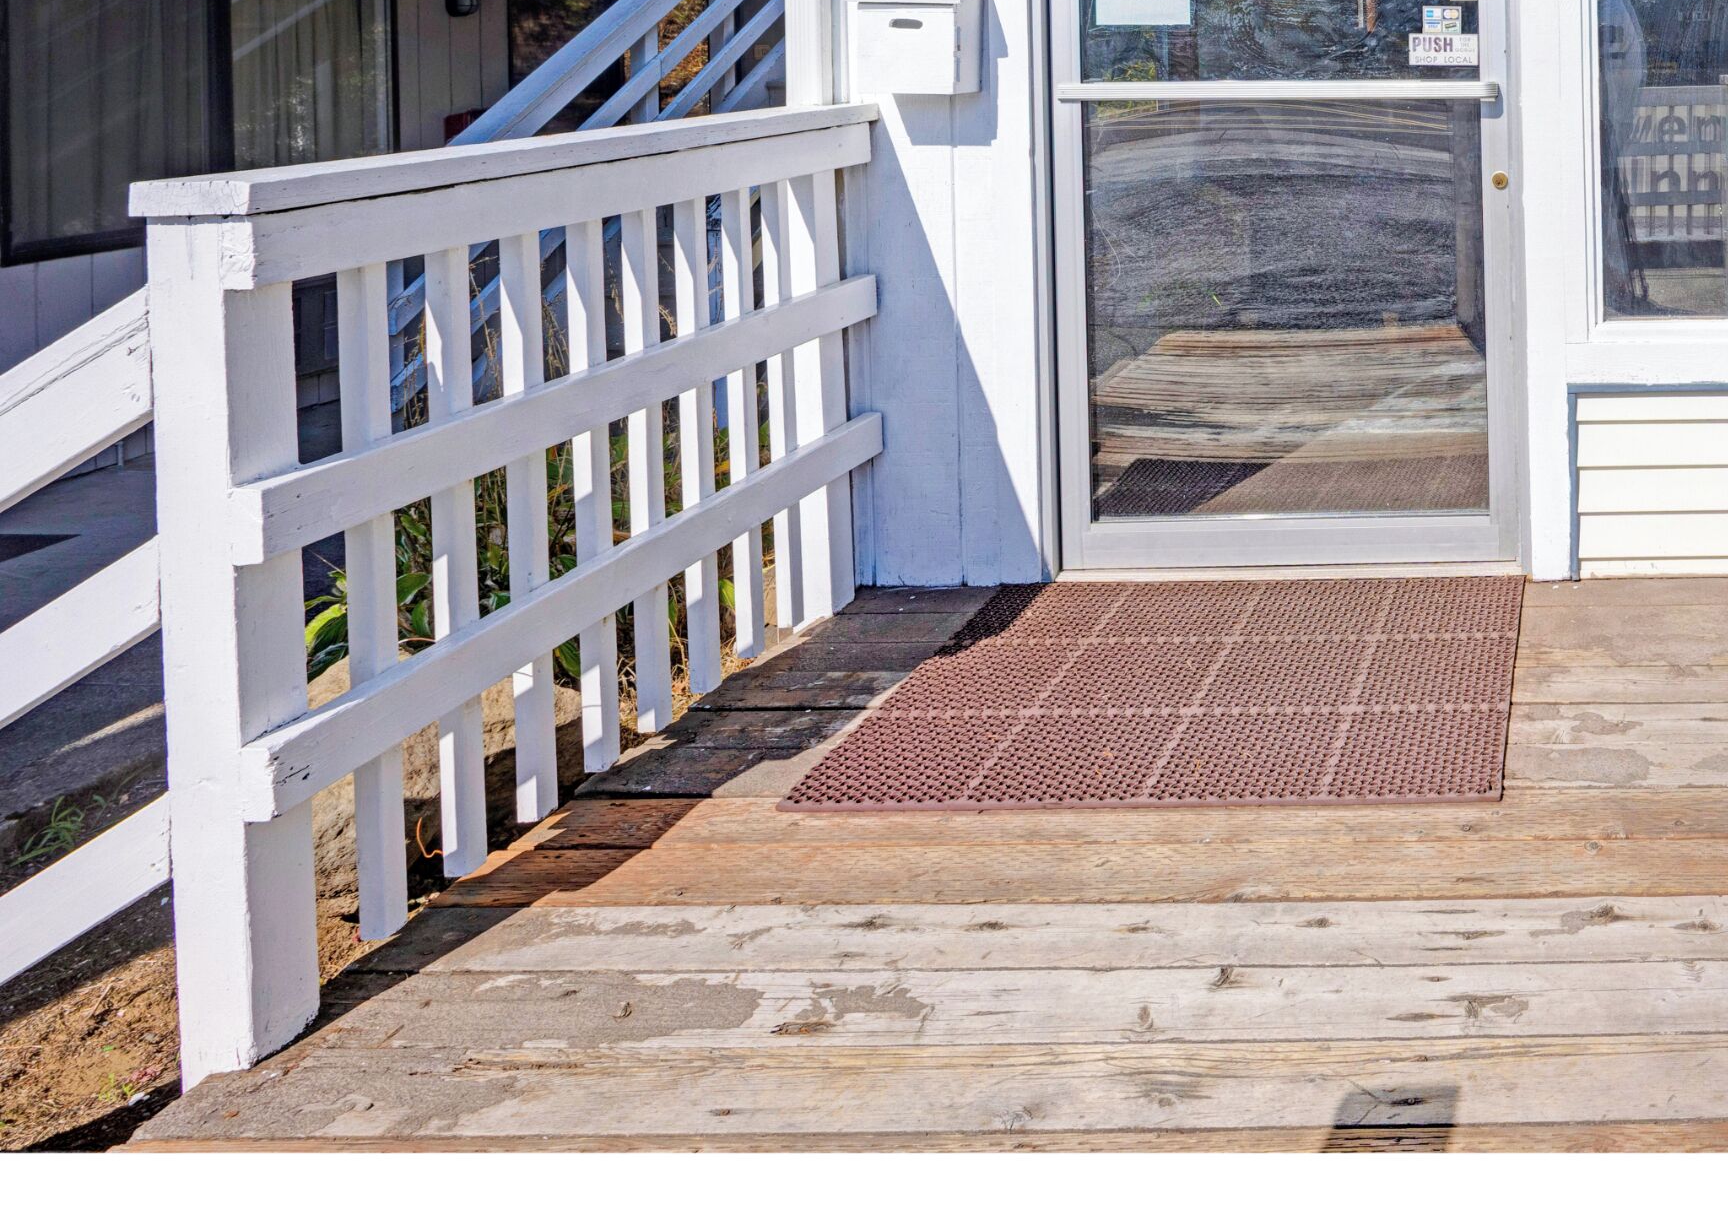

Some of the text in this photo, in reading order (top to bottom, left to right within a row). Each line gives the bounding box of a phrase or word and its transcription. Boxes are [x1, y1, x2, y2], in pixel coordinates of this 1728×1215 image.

[1412, 37, 1453, 53] PUSH
[1415, 56, 1472, 64] SHOP LOCAL
